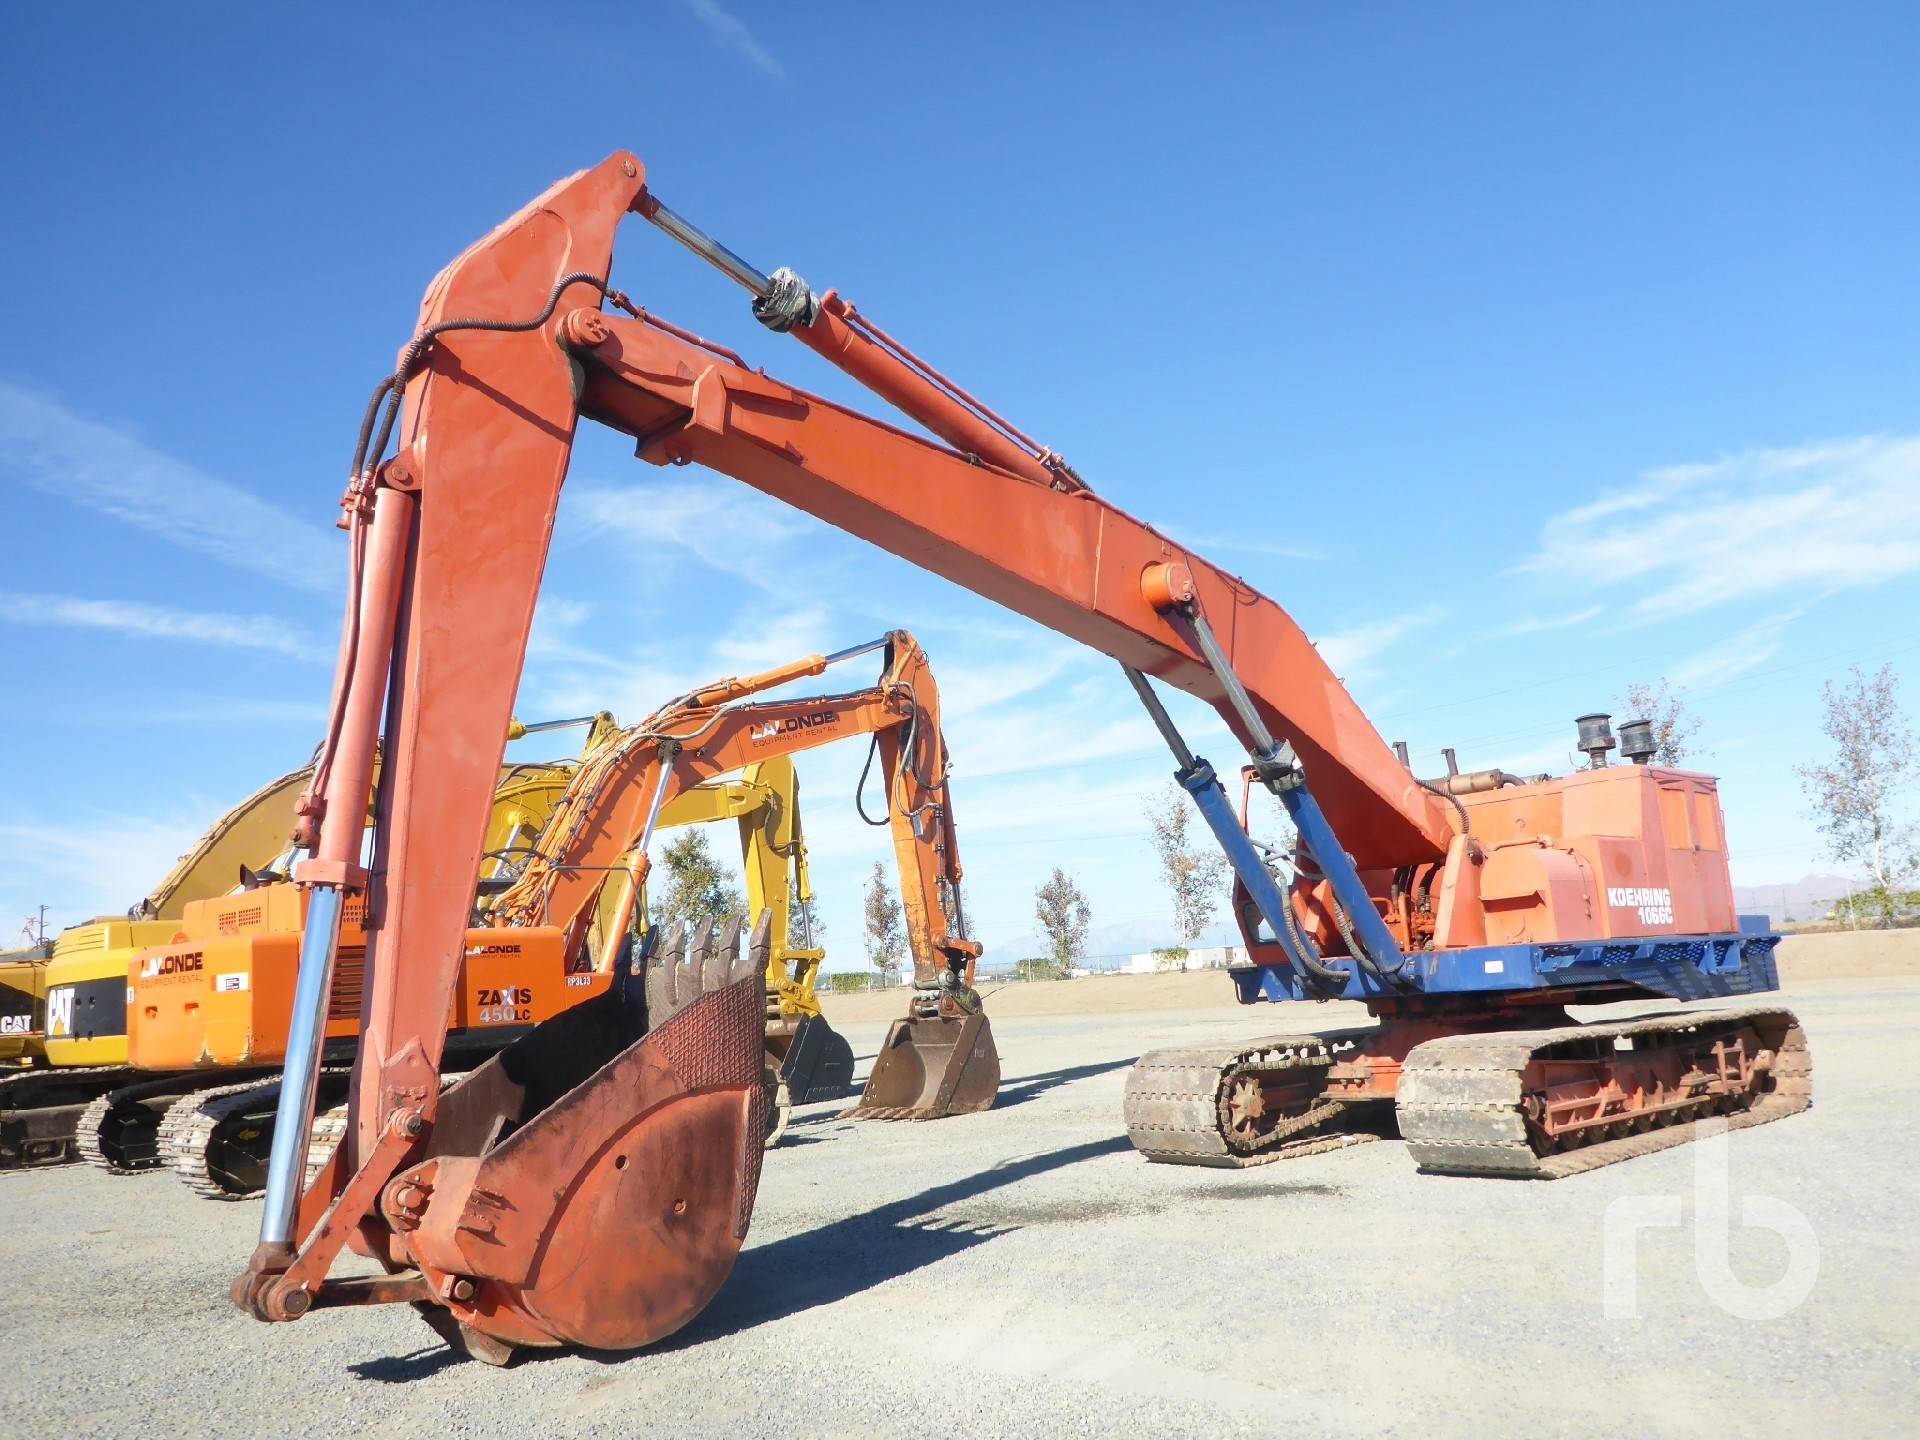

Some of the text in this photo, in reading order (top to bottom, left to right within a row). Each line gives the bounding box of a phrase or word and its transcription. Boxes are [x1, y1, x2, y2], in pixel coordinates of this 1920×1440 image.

[750, 711, 836, 740] LALONDE
[1607, 888, 1671, 907] KOEHRING
[1638, 907, 1673, 925] 1066C
[140, 952, 203, 977] LALONDE
[478, 986, 532, 1007] ZAXIS
[47, 988, 76, 1036] CAT
[0, 1015, 32, 1033] CAT
